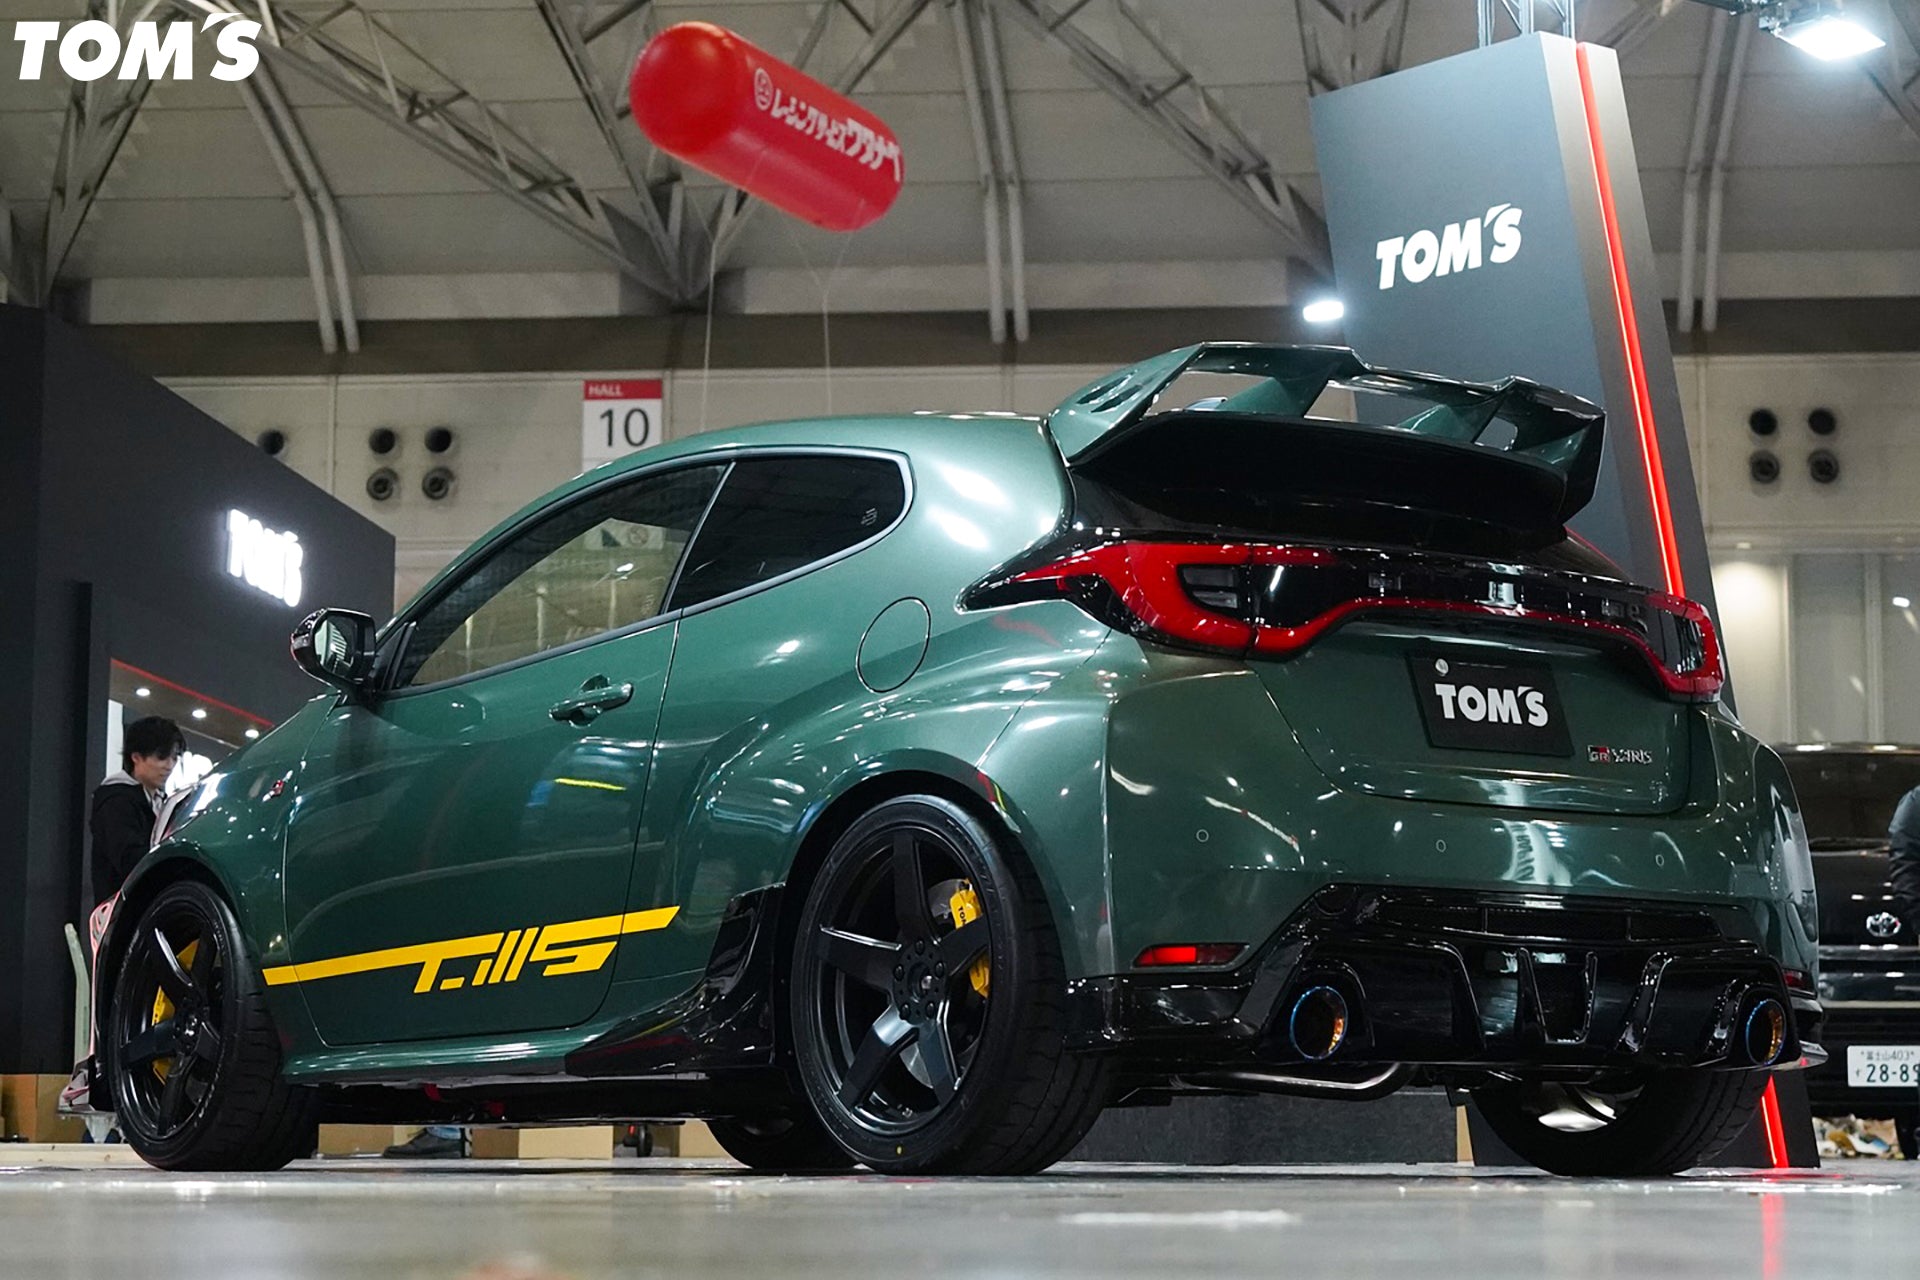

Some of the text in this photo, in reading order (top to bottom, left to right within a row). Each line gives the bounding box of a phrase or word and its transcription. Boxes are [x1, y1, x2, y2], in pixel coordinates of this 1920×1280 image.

[1375, 202, 1523, 290] TOM'S
[587, 382, 624, 397] HALL
[600, 408, 650, 447] 10
[1434, 683, 1549, 728] TOM'S
